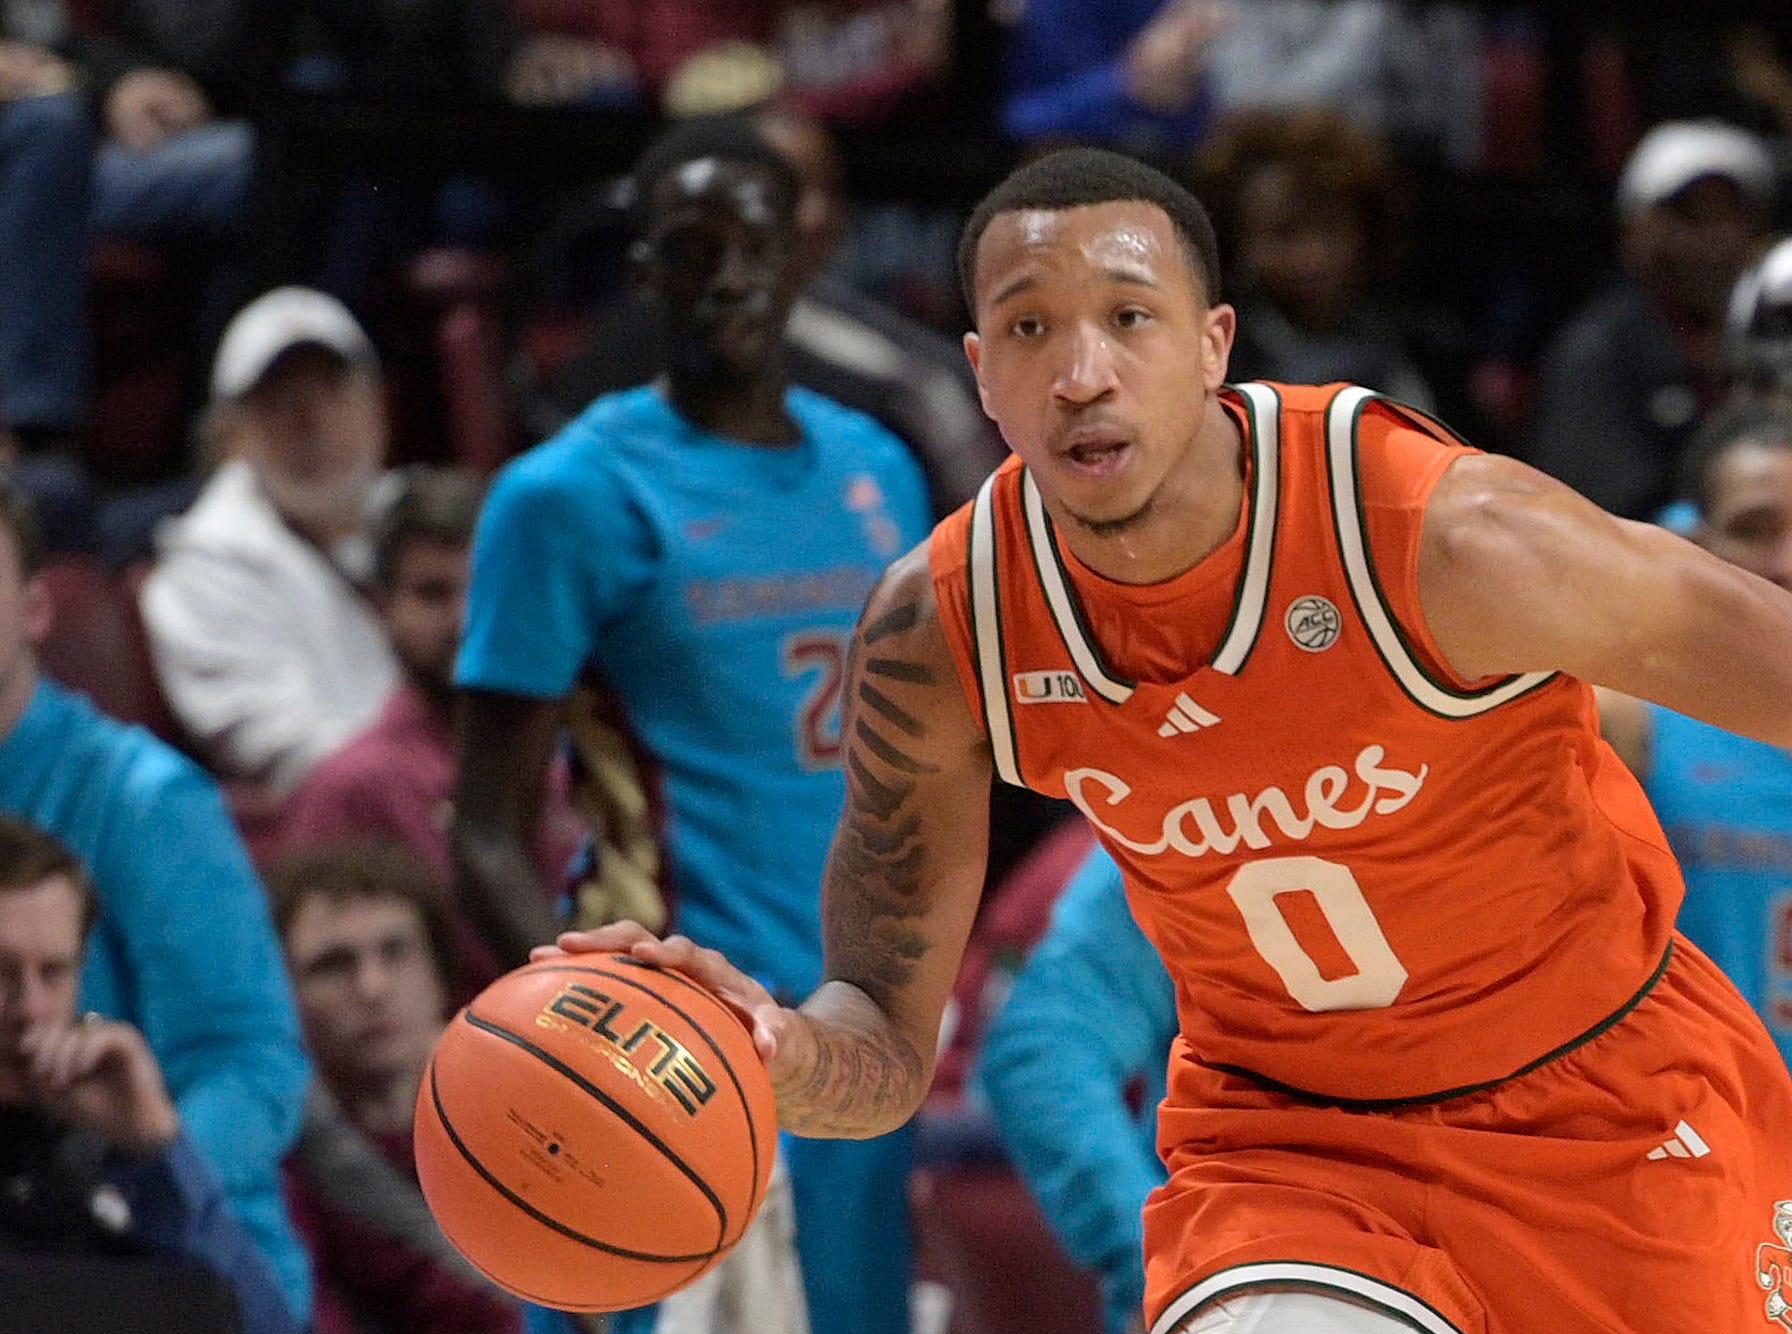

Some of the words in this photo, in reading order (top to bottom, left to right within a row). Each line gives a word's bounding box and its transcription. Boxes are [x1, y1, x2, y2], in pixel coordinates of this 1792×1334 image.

[1295, 609, 1334, 633] ACC
[1063, 744, 1429, 857] Canes
[1226, 855, 1409, 1013] 0
[548, 982, 717, 1117] ELITE
